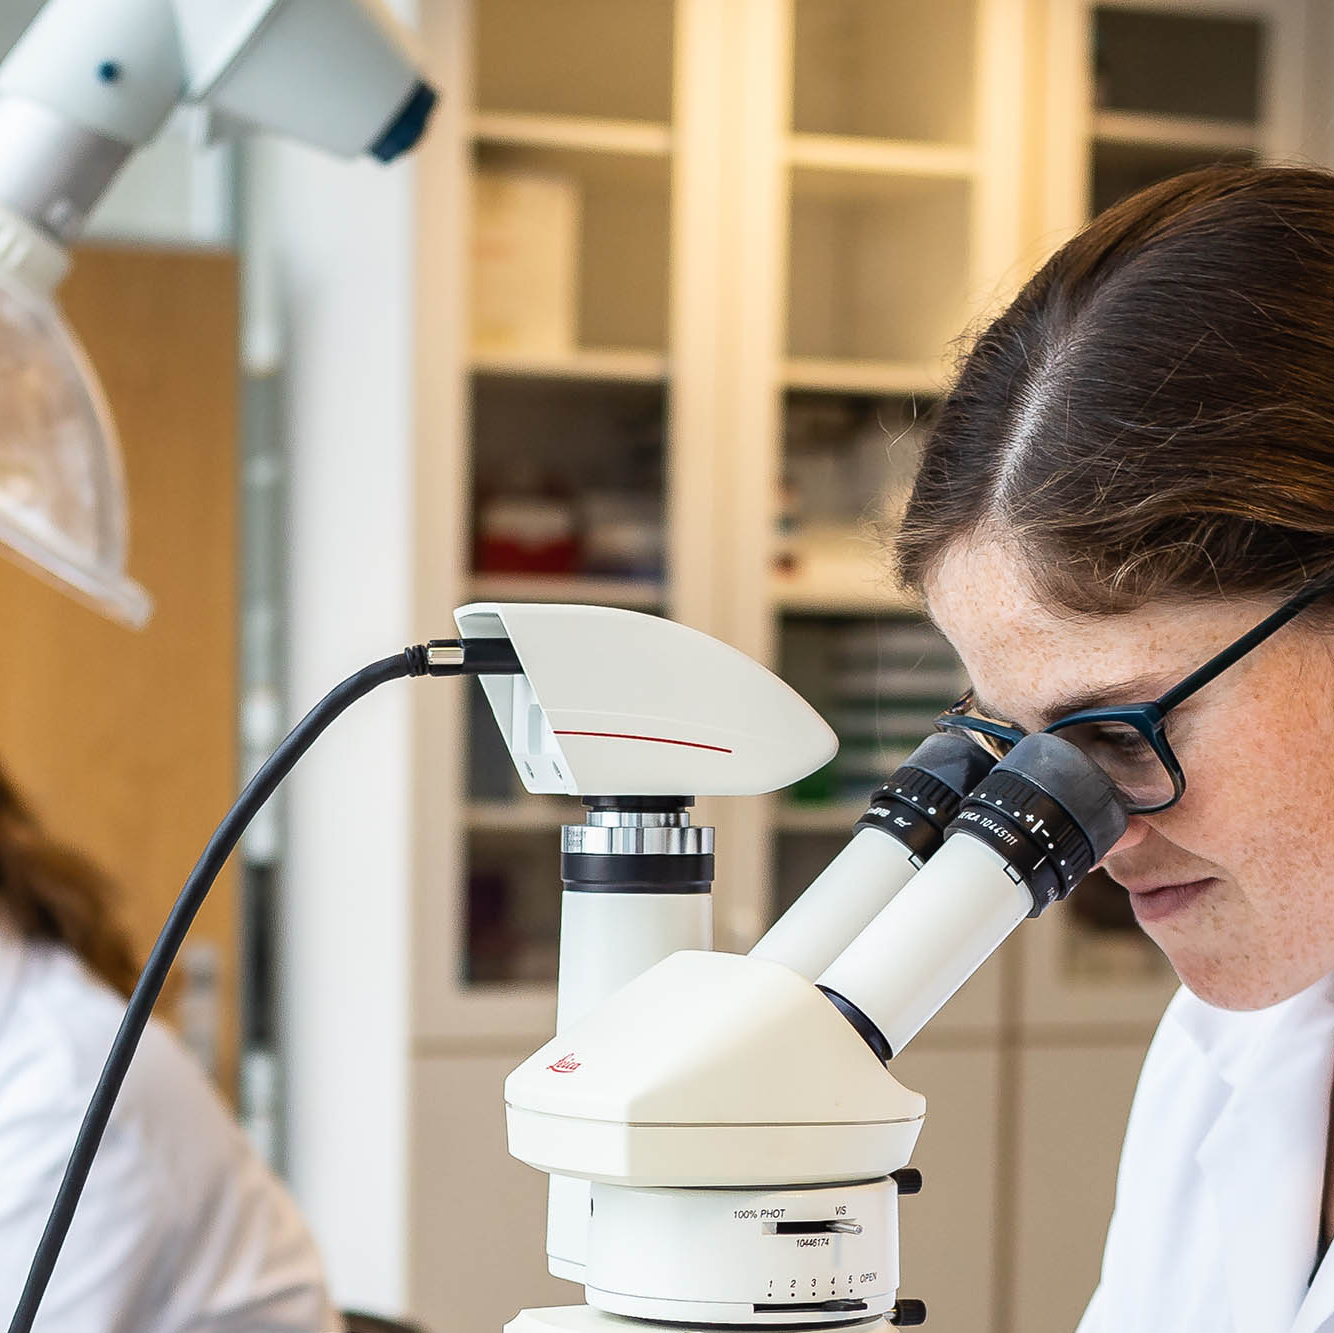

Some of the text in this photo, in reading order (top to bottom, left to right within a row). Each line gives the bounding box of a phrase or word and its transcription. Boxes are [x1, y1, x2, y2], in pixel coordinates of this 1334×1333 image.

[979, 817, 1019, 847] 10445111
[546, 1053, 582, 1074] Leica
[733, 1205, 848, 1220] 100% PHOT VIS
[768, 1279, 774, 1289] 1
[789, 1279, 797, 1289] 2
[810, 1277, 817, 1288] 3
[830, 1275, 836, 1286] 4
[859, 1271, 878, 1284] OPEN
